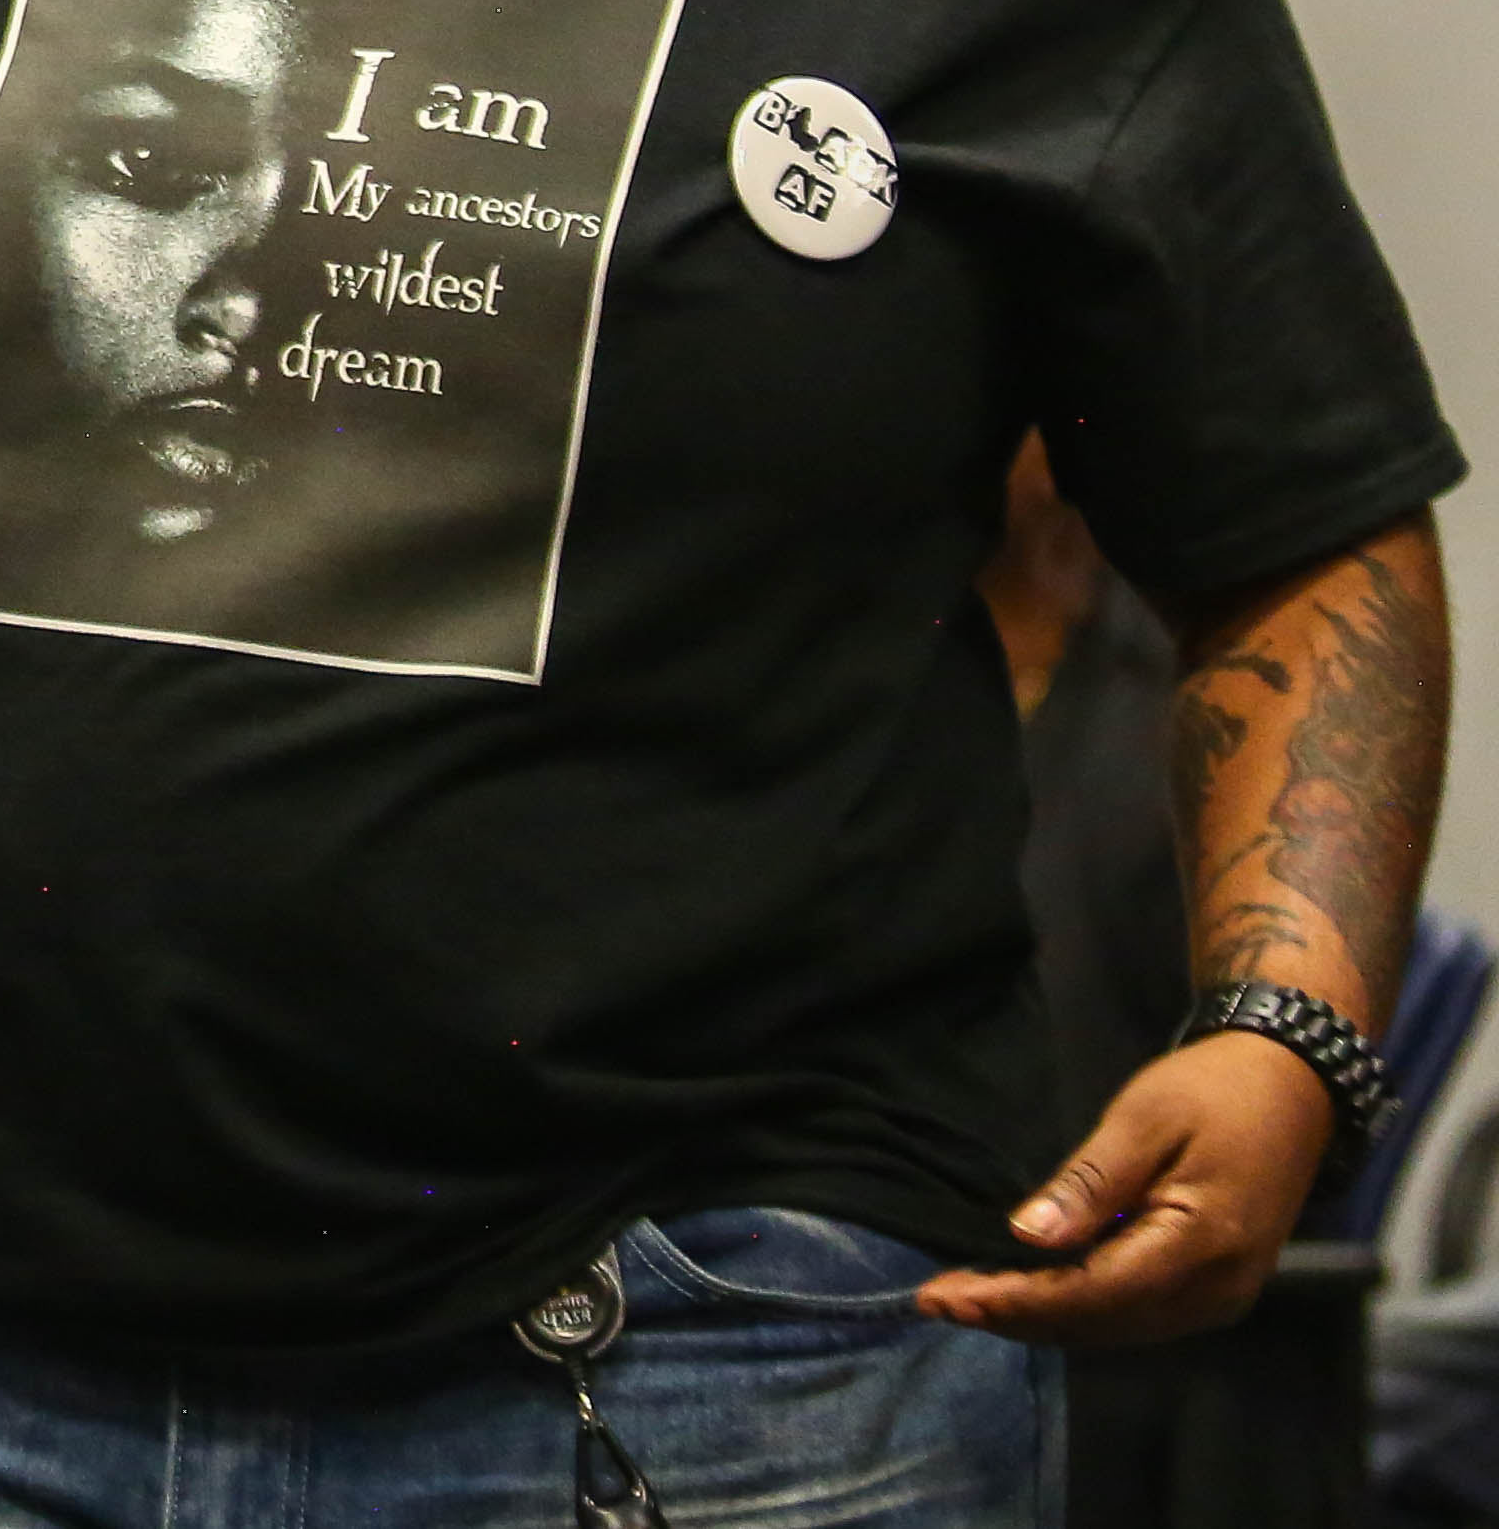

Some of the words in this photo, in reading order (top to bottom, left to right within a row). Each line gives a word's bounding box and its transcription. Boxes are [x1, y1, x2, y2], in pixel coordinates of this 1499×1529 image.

[326, 48, 396, 145] I
[415, 81, 551, 150] am
[754, 89, 899, 208] BLAK
[775, 163, 836, 222] AF
[302, 158, 394, 223] My
[407, 186, 603, 247] ancestors
[323, 239, 505, 316] wildest
[280, 312, 444, 401] dream
